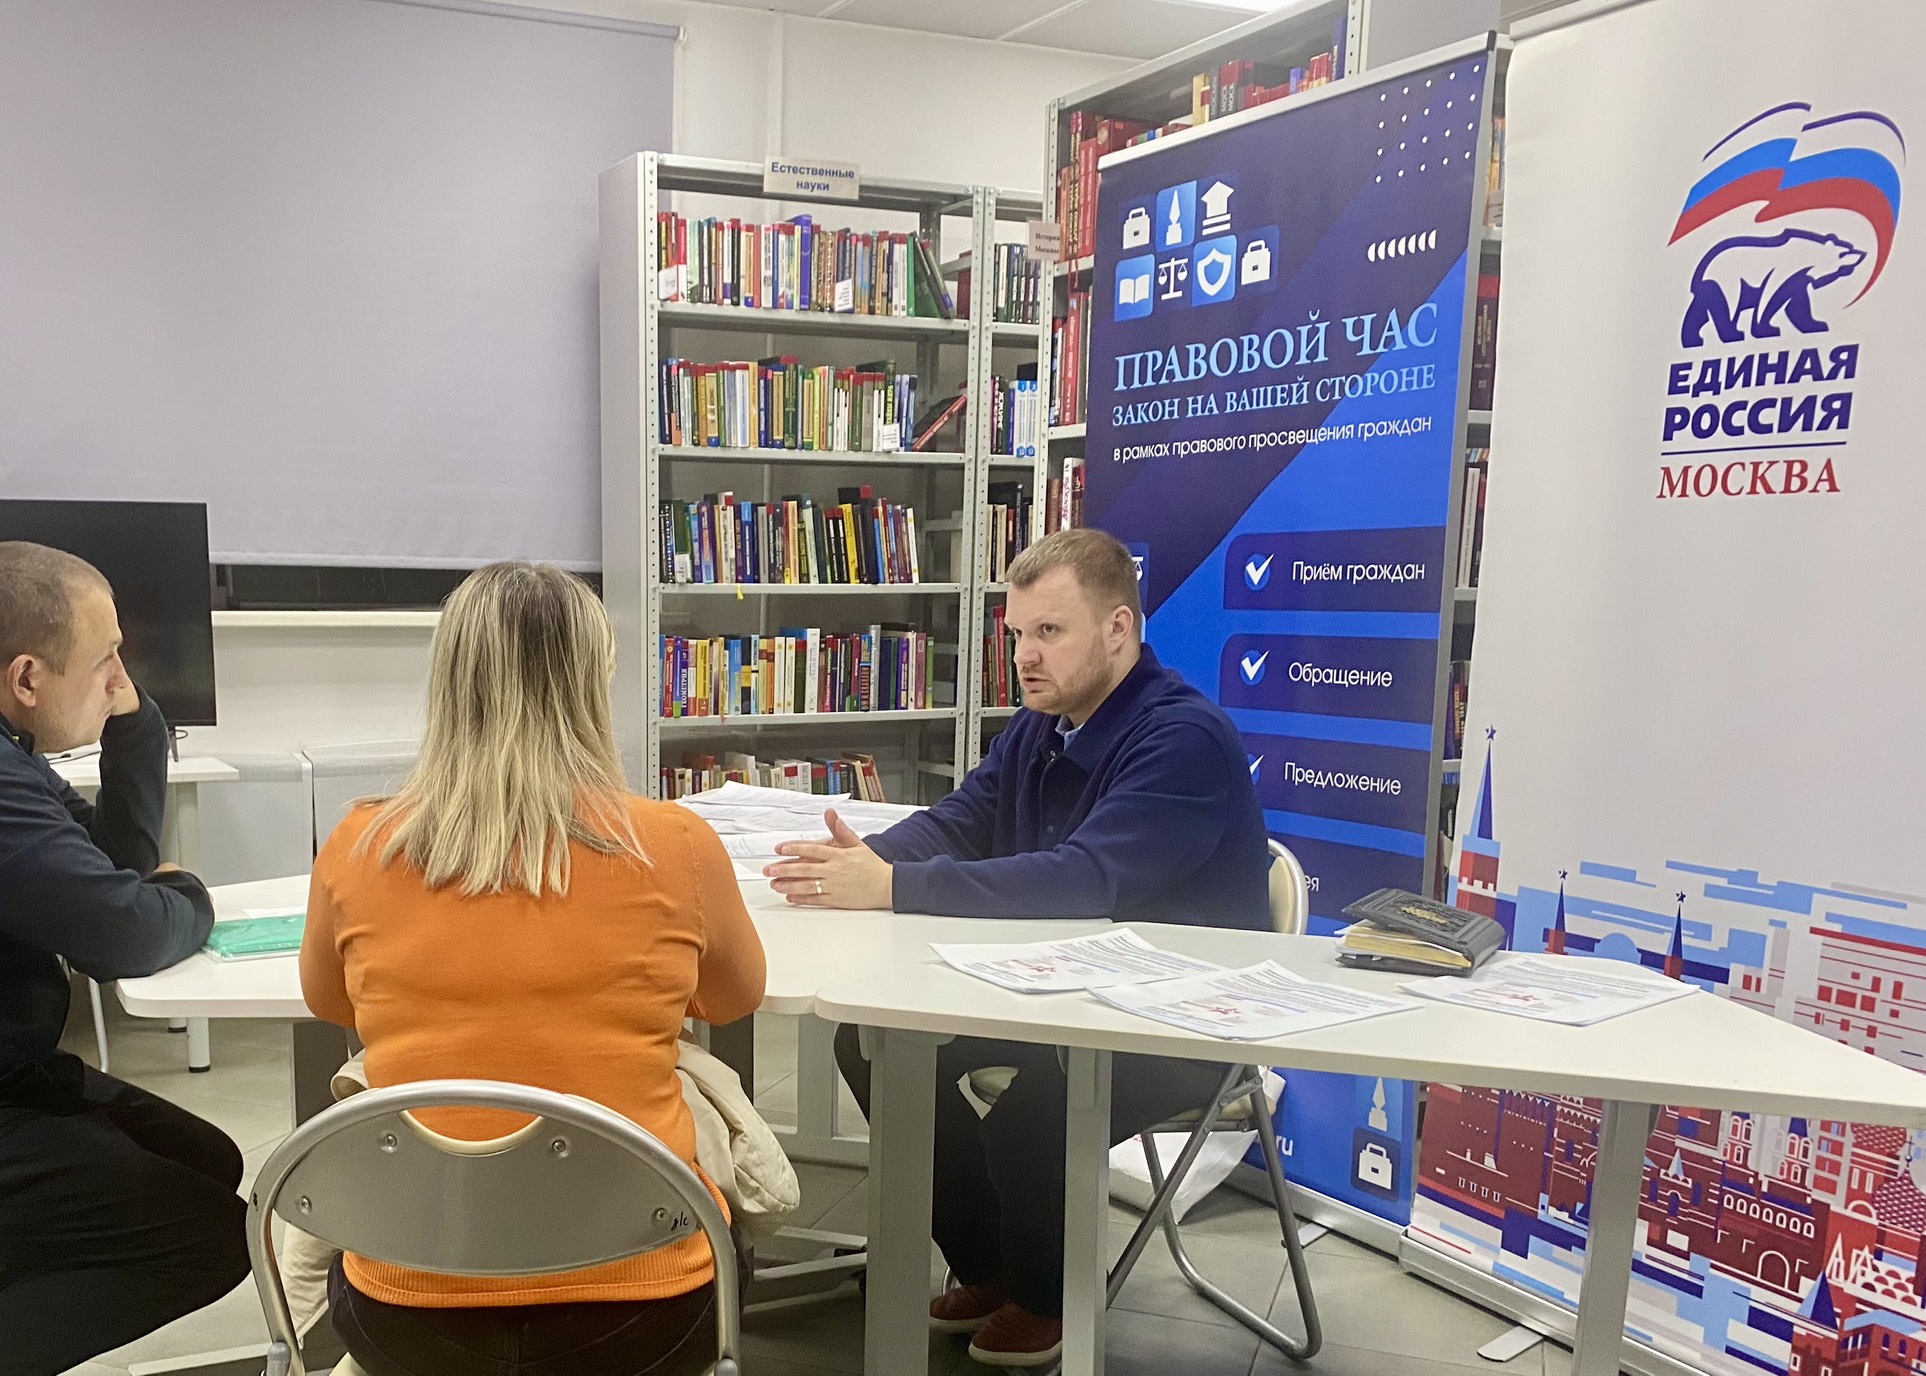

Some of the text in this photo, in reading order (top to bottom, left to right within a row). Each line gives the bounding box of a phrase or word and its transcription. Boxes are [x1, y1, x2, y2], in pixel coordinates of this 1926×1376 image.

[771, 162, 855, 178] Естественные
[796, 181, 830, 192] науки
[1114, 309, 1331, 391] ПРАВОВОЙ
[1341, 302, 1438, 358] ЧАС
[1667, 344, 1859, 397] ЕДИНАЯ
[1112, 364, 1436, 427] ЗАКОН НА ВАШЕЙ СТОРОНЕ
[1662, 392, 1853, 442] РОССИЯ
[1113, 415, 1432, 464] в рамках правового просвещения граждан
[1656, 458, 1840, 499] МОСКВА
[1292, 561, 1425, 584] Приём граждан
[1289, 661, 1393, 688] Обращение
[1284, 762, 1401, 795] Предложение
[1304, 875, 1319, 891] ея
[1276, 1135, 1293, 1156] ru
